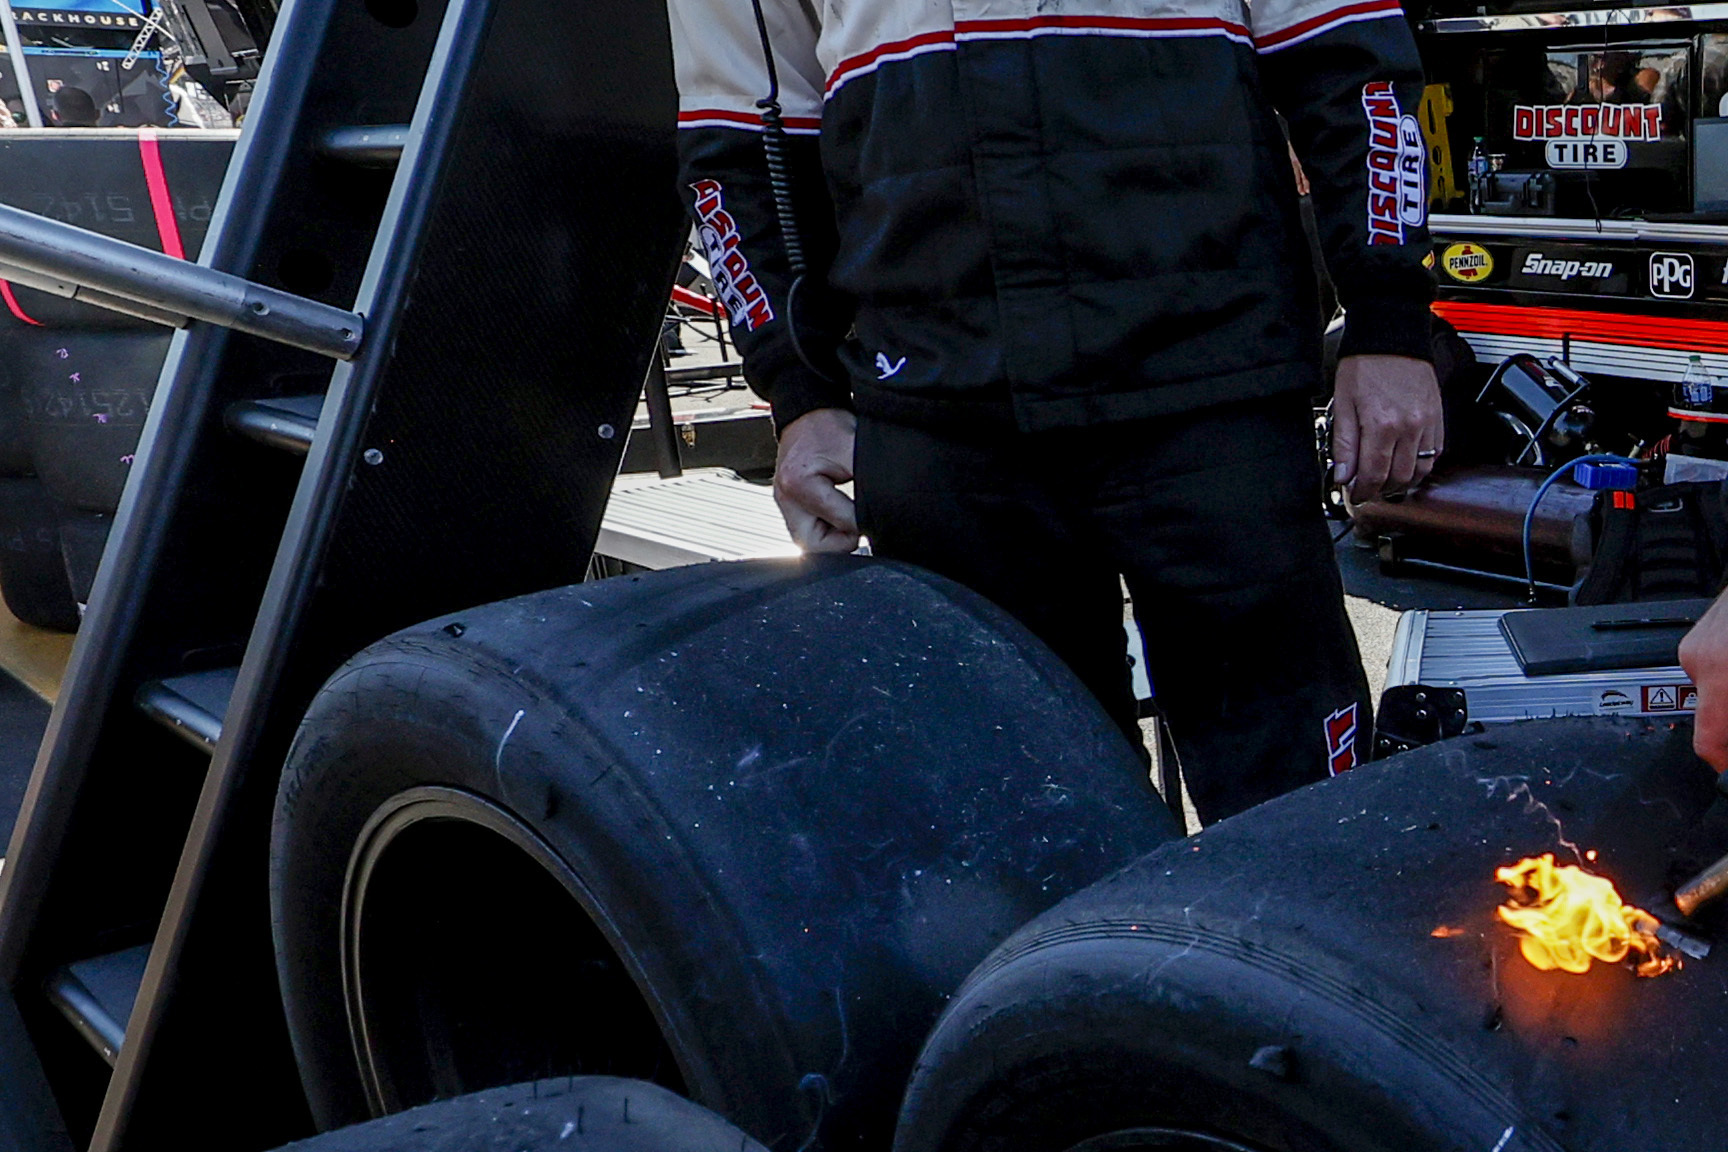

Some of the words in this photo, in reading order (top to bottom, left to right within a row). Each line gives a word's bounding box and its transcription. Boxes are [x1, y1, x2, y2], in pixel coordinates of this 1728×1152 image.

[1514, 103, 1661, 141] DISCOUNT
[1553, 143, 1617, 163] TIRE
[1402, 129, 1419, 213] TIRE
[1449, 254, 1486, 269] PENNZOIL
[1521, 253, 1613, 281] Snap-on
[1652, 257, 1691, 293] PPG
